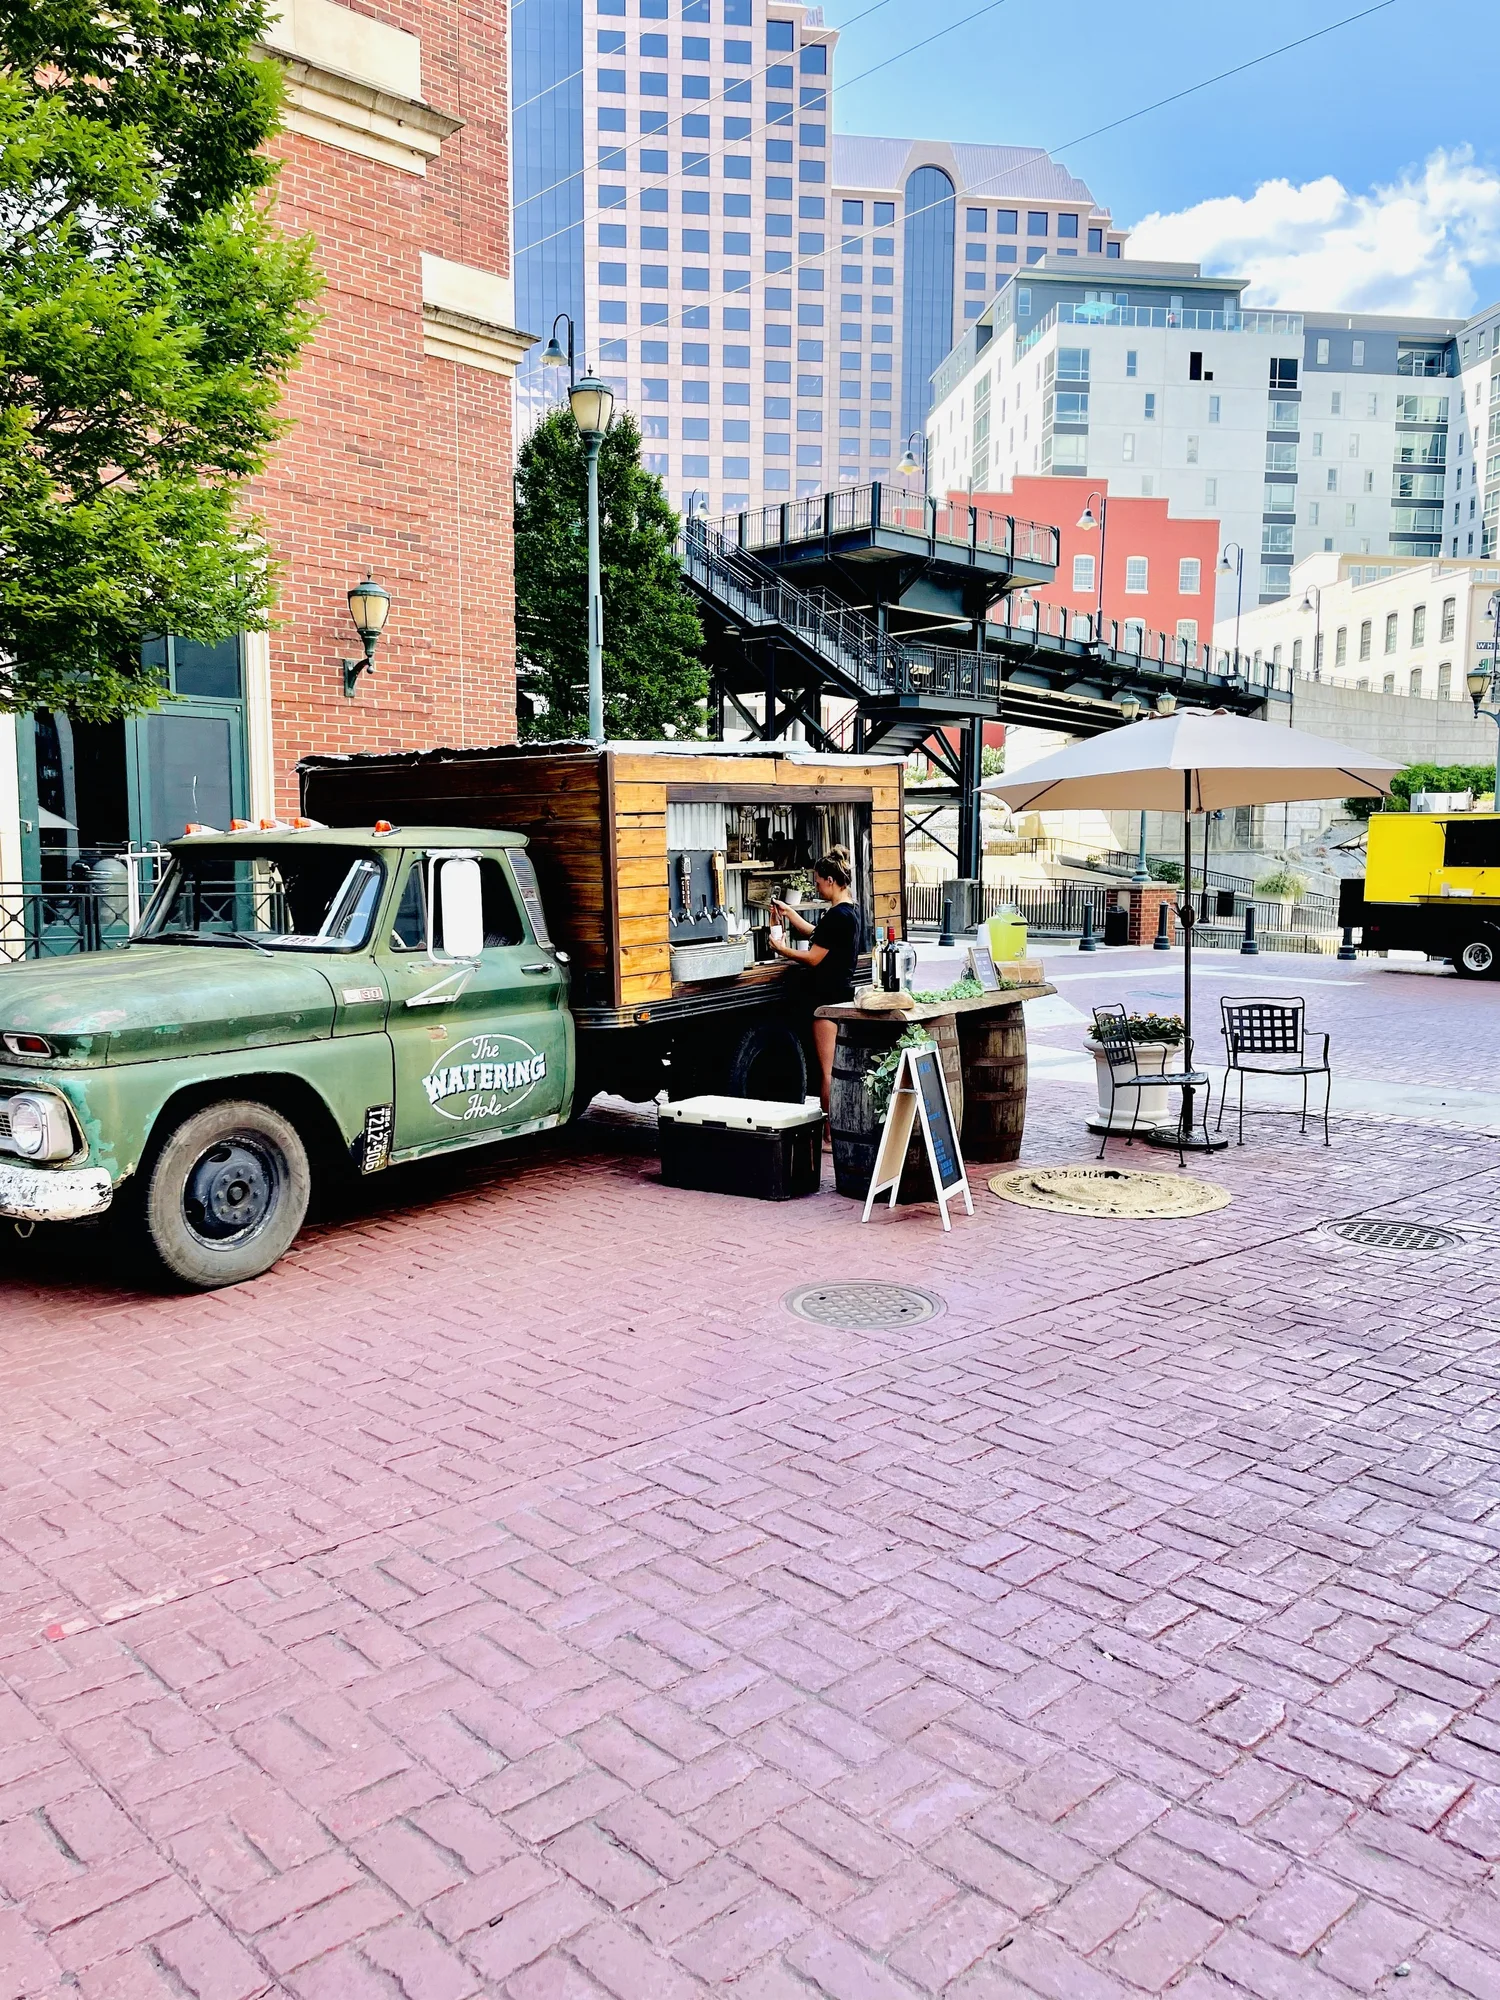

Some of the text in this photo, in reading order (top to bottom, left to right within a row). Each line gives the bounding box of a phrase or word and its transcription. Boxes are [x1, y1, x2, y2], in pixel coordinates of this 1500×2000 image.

[471, 1037, 499, 1059] The
[422, 1052, 546, 1104] WATERING
[464, 1094, 507, 1120] Hole
